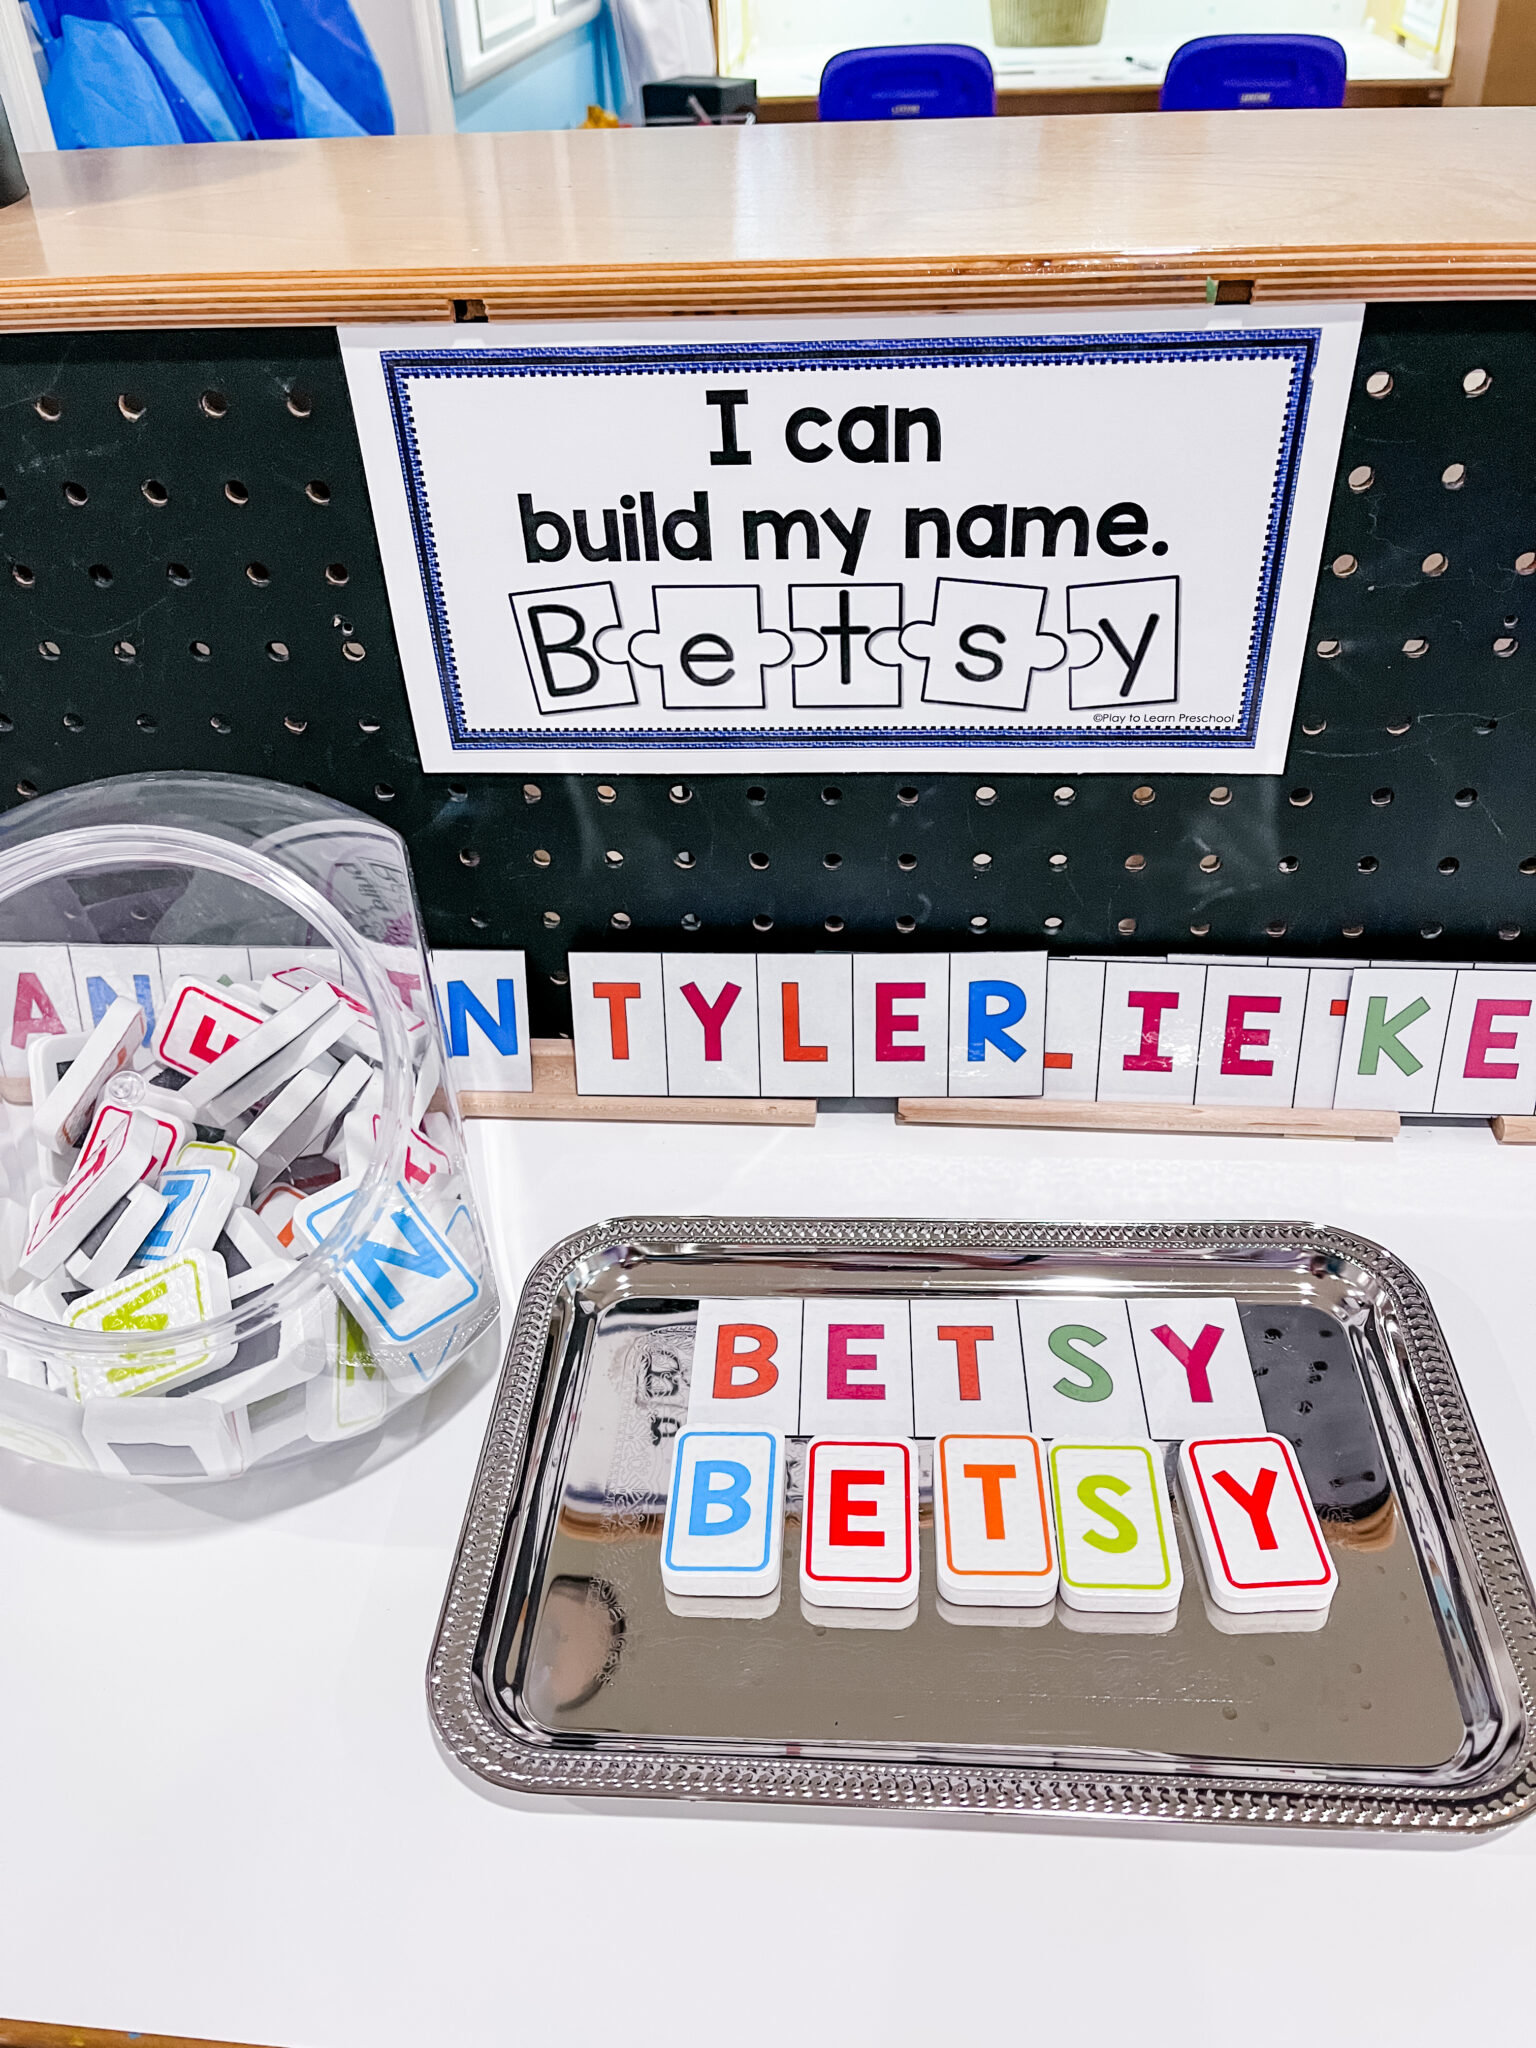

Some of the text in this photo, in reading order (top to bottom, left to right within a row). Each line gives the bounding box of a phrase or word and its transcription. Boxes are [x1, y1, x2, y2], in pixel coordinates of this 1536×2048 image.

[705, 388, 942, 466] I can
[517, 490, 1169, 577] build my name.
[528, 588, 1160, 699] Betsy
[1129, 714, 1141, 723] to
[1143, 714, 1176, 723] Learn
[1178, 713, 1235, 723] Preschool
[592, 979, 1028, 1063] TYLER
[712, 1322, 1225, 1404] BETSY
[688, 1459, 1279, 1552] BETSY
